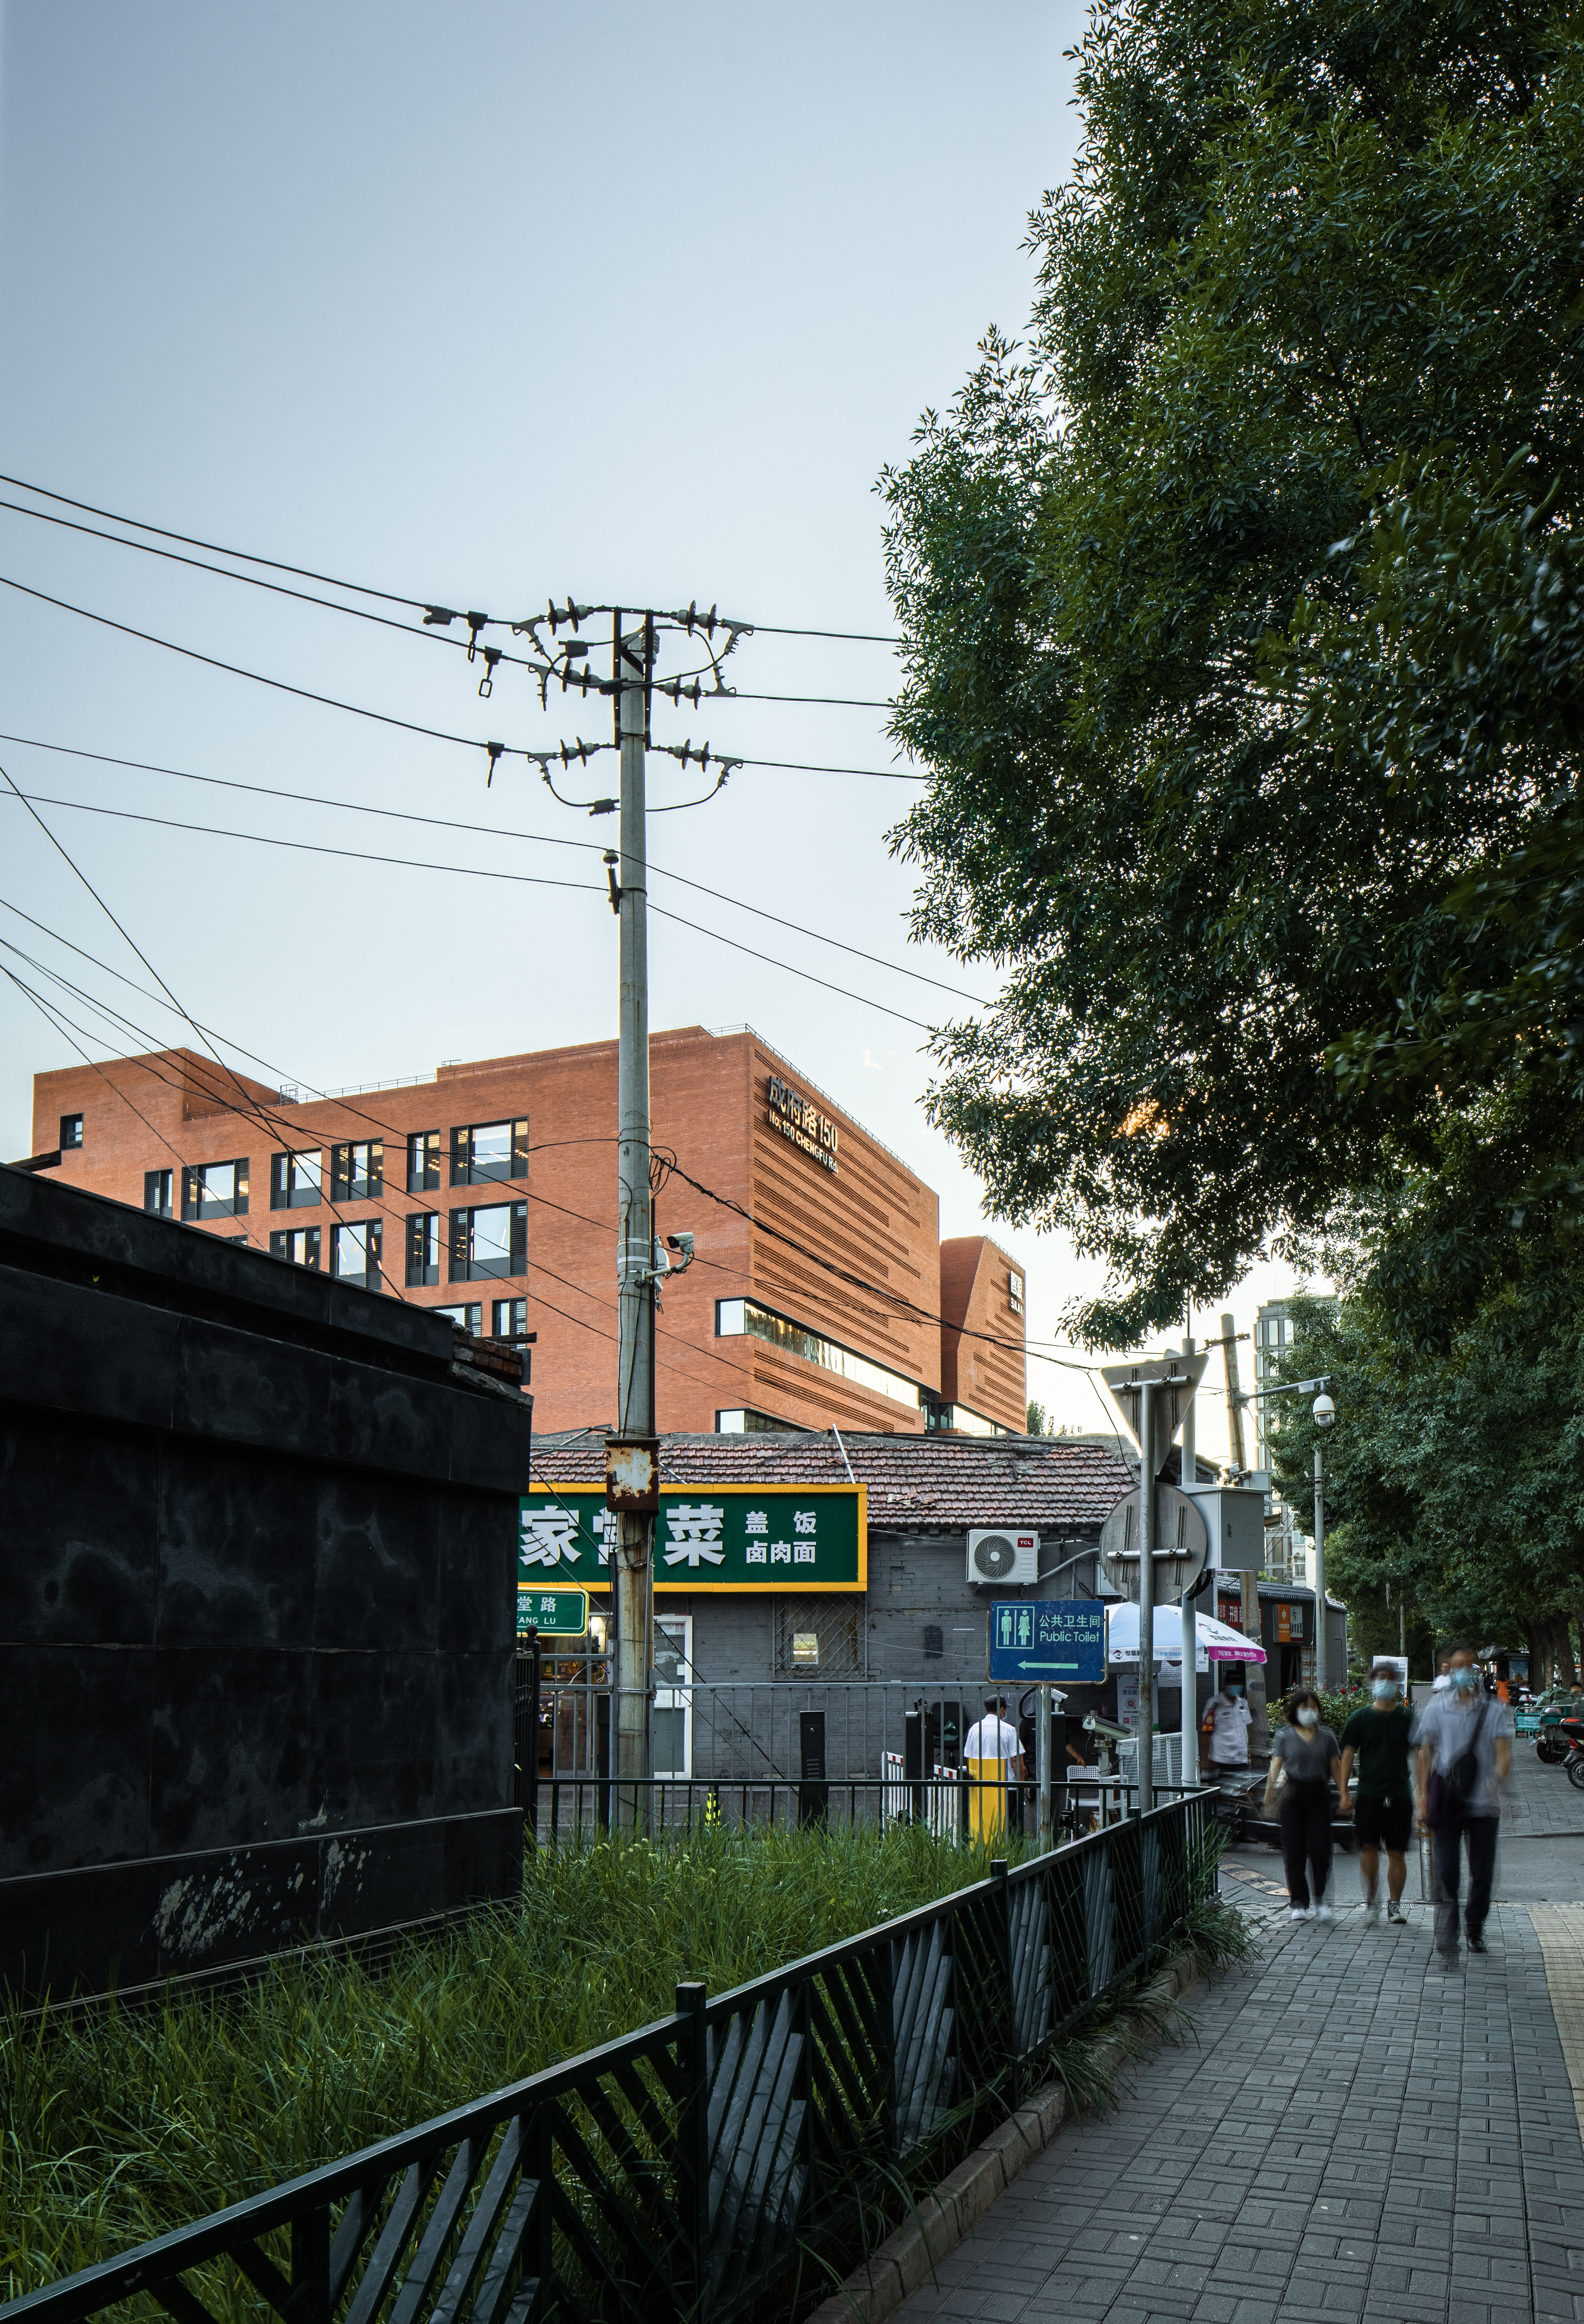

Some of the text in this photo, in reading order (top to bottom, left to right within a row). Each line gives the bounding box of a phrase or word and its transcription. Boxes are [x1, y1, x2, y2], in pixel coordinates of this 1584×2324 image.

[769, 1075, 838, 1152] 成府路150
[769, 1109, 839, 1173] No. 150 CHENGFU Rd.
[746, 1541, 816, 1563] 卤肉面
[1039, 1615, 1100, 1628] 公共卫生间
[1040, 1631, 1100, 1642] Public Toilet
